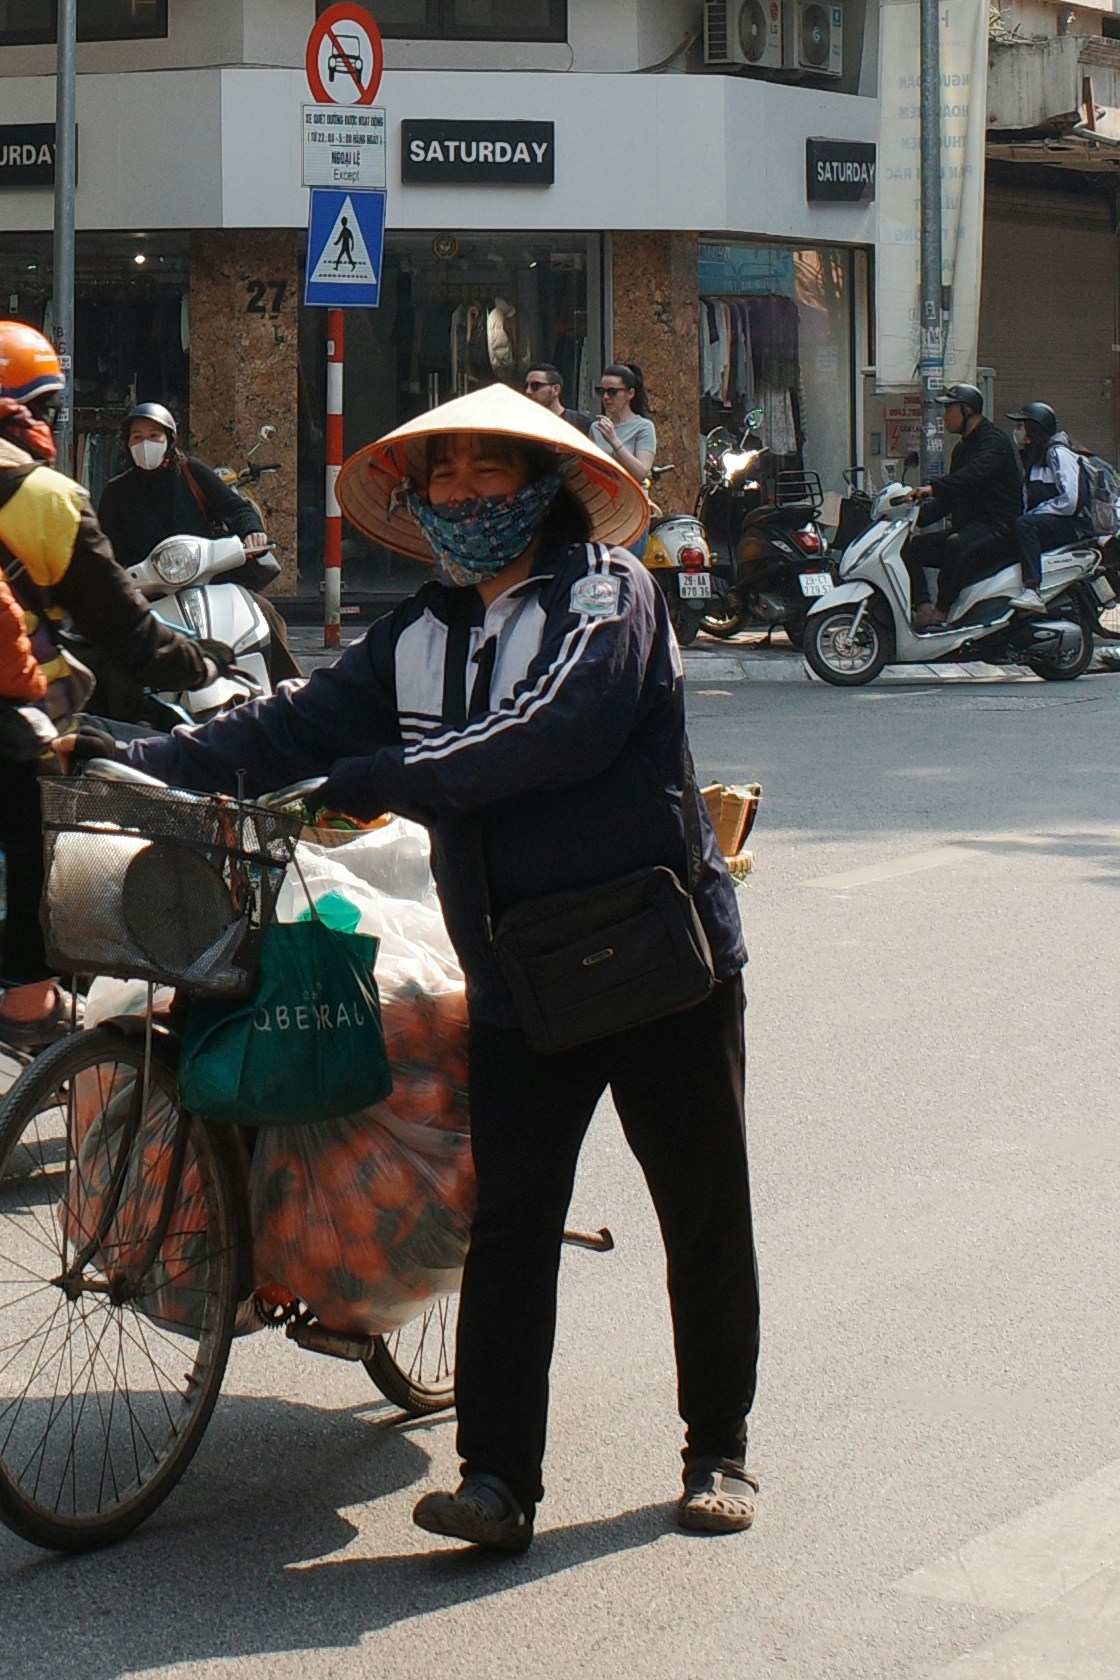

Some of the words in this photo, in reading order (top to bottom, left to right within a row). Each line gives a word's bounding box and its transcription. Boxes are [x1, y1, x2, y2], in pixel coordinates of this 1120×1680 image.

[410, 139, 548, 163] SATURDAY
[333, 168, 360, 184] Except
[817, 161, 875, 183] SATURDAY
[247, 280, 288, 313] 27
